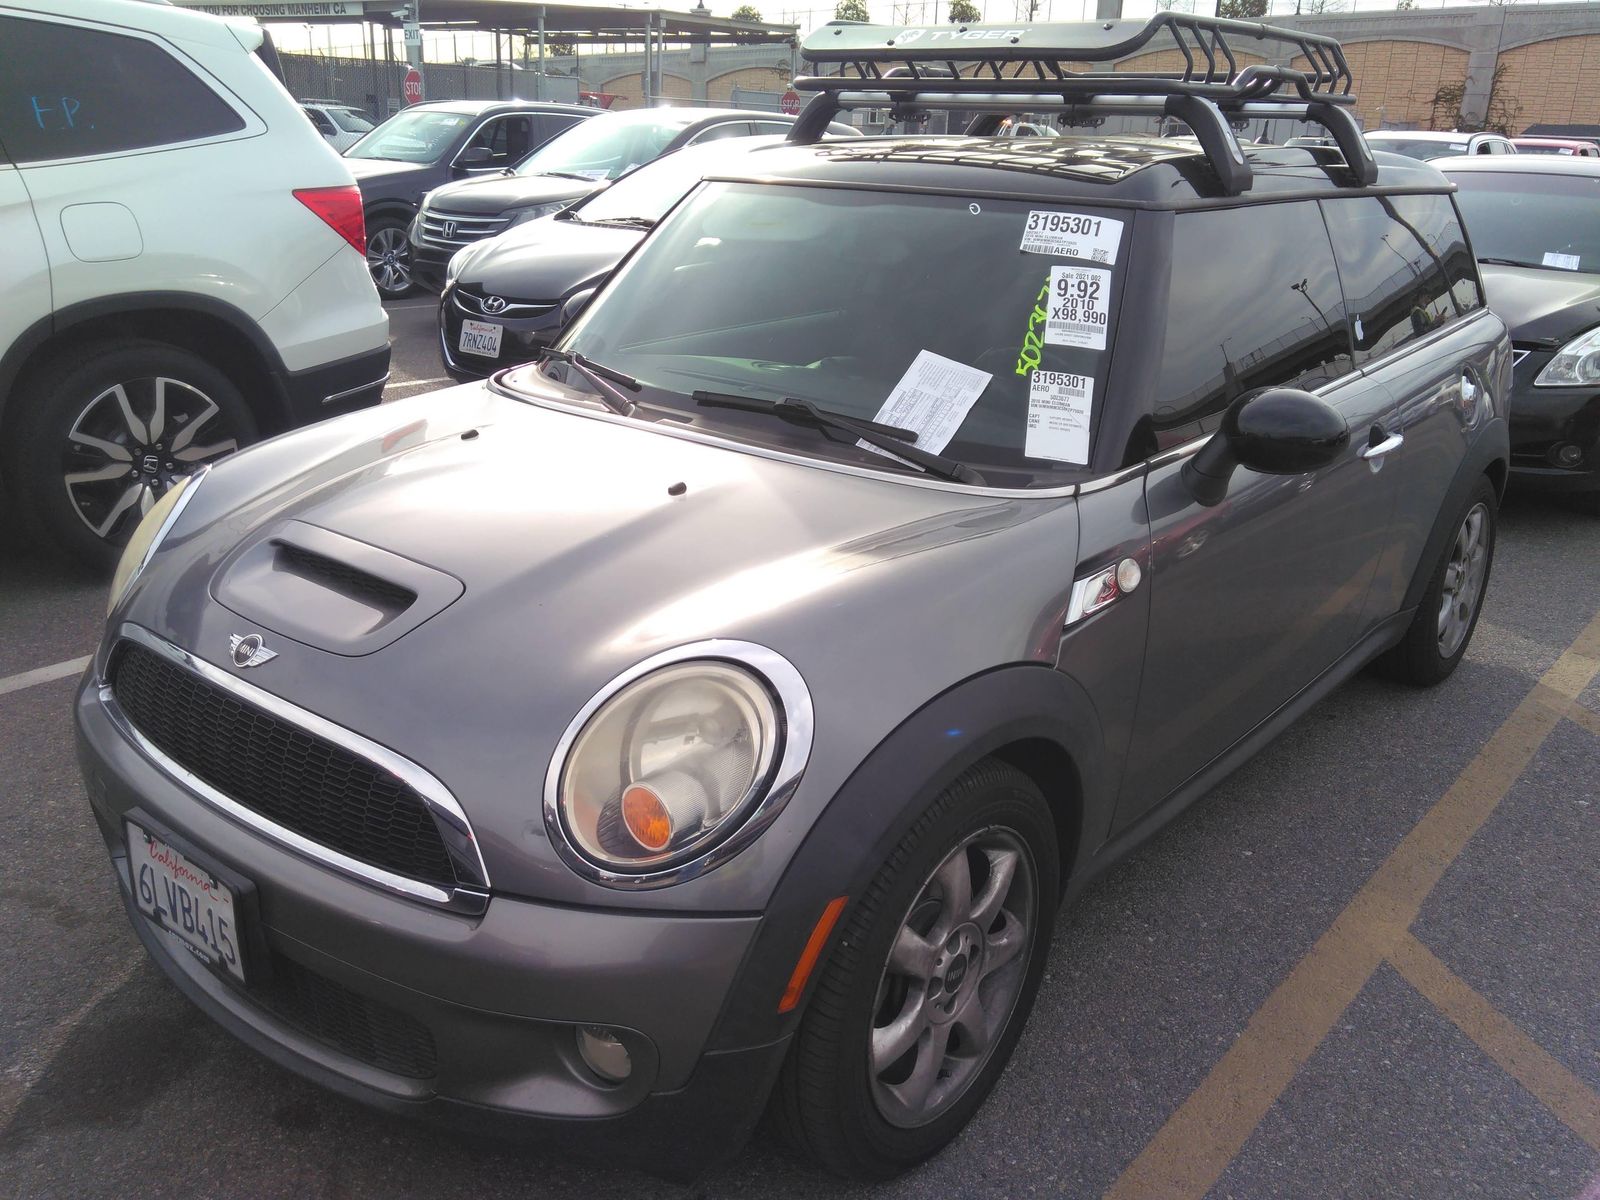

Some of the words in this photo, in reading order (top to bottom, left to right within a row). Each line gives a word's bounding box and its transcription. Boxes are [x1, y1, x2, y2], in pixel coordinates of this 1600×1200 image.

[222, 4, 239, 16] FOR
[241, 3, 286, 16] CHOOSING
[287, 3, 331, 15] MANHEIM
[333, 2, 347, 15] CA
[404, 29, 420, 40] EXIT
[930, 29, 1025, 41] TYGER
[782, 99, 800, 110] STOP
[1028, 214, 1102, 237] 3195301
[1054, 246, 1079, 257] AERO
[1061, 271, 1074, 279] Sale
[1075, 272, 1089, 281] 2021
[1057, 279, 1101, 301] 9:92
[1062, 297, 1095, 311] 2010
[1052, 307, 1107, 325] X98,990
[462, 332, 497, 352] 7RNZ404
[1033, 371, 1086, 390] 3195301
[1031, 384, 1050, 393] AERO
[240, 643, 256, 657] MINI
[149, 840, 216, 899] California
[138, 862, 237, 967] 6LVB415
